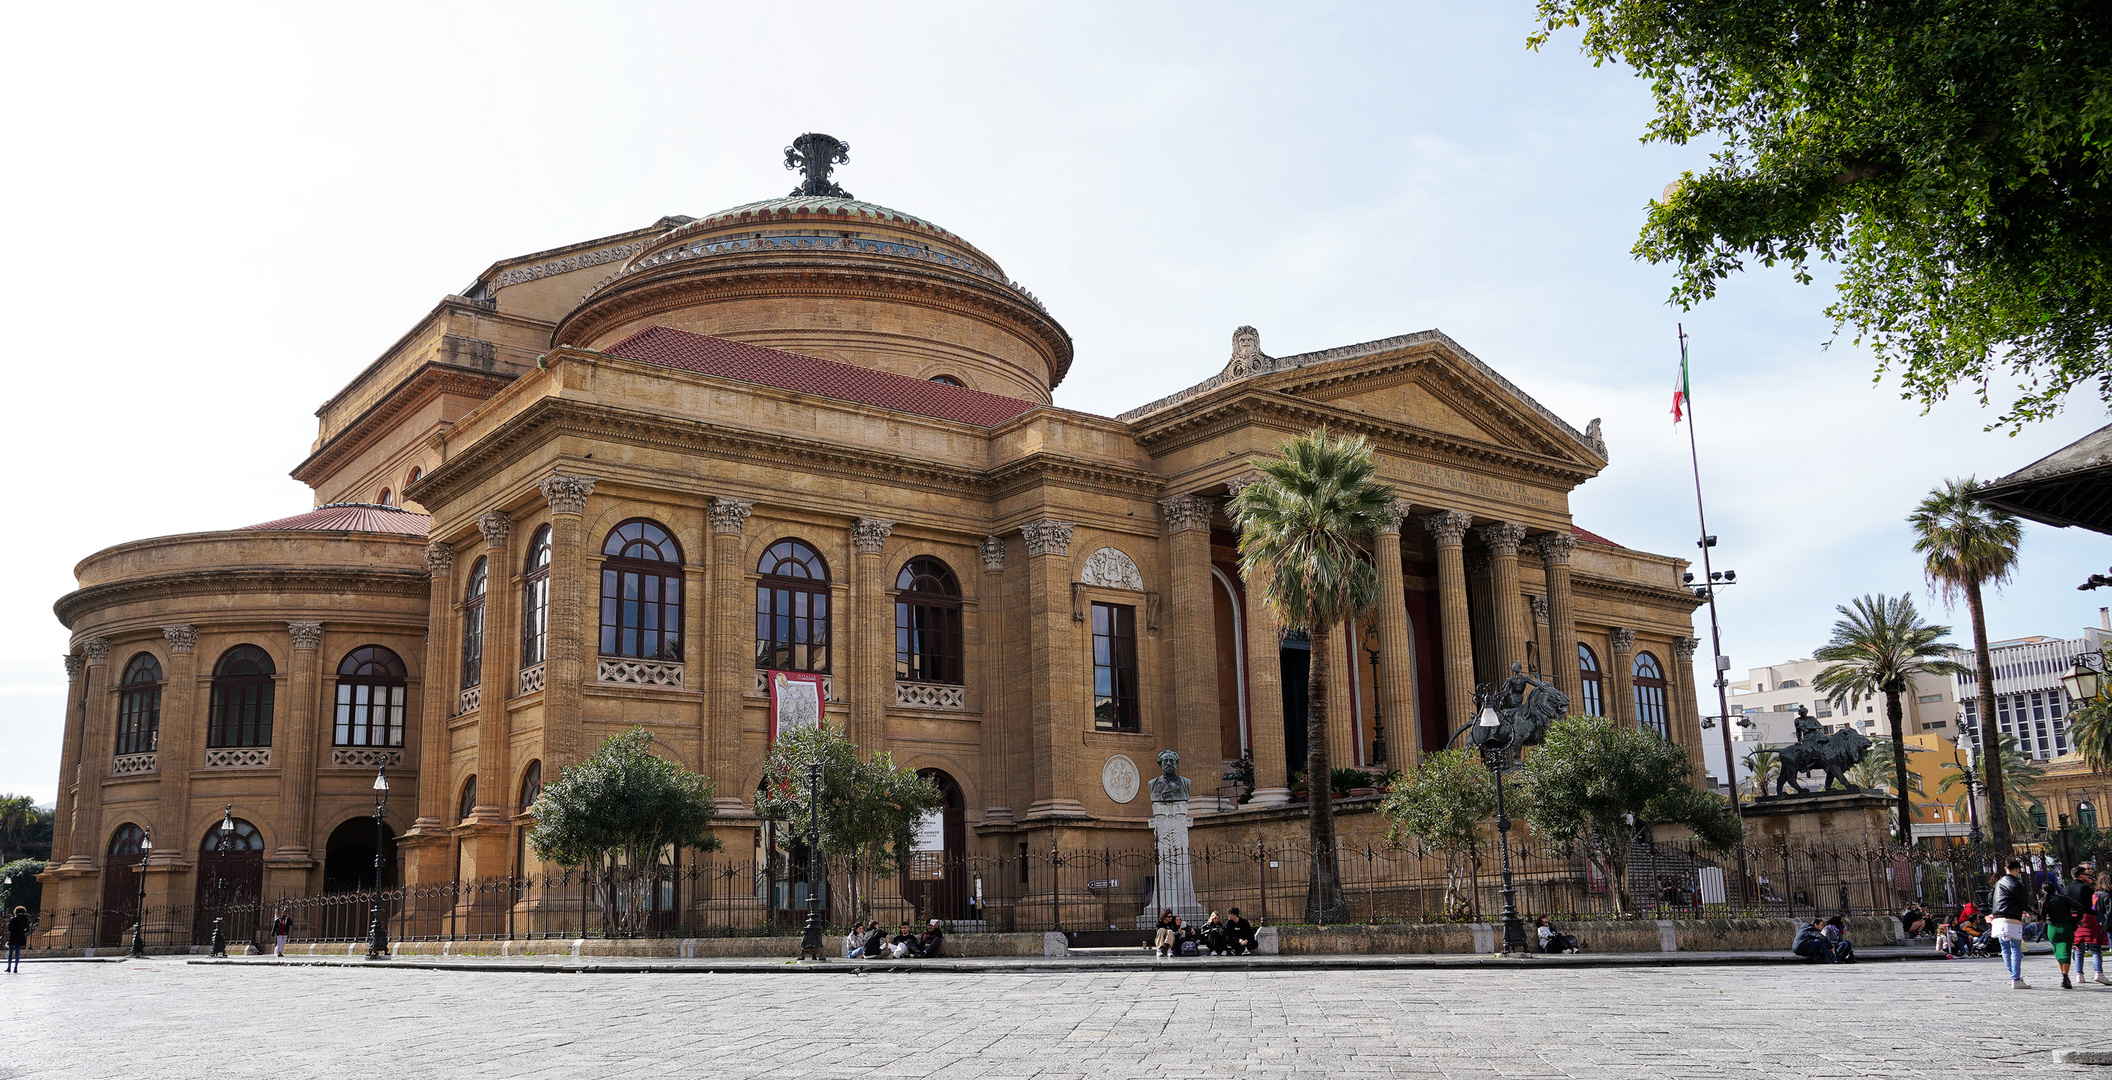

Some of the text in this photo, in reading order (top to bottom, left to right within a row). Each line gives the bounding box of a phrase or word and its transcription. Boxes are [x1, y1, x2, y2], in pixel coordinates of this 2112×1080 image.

[1399, 459, 1432, 474] POPOLI
[1444, 469, 1456, 479] NE
[1460, 472, 1491, 487] RIVELA
[1494, 480, 1505, 491] LA
[1507, 482, 1528, 495] VITA
[1410, 471, 1425, 481] OVE
[1429, 476, 1445, 485] NON
